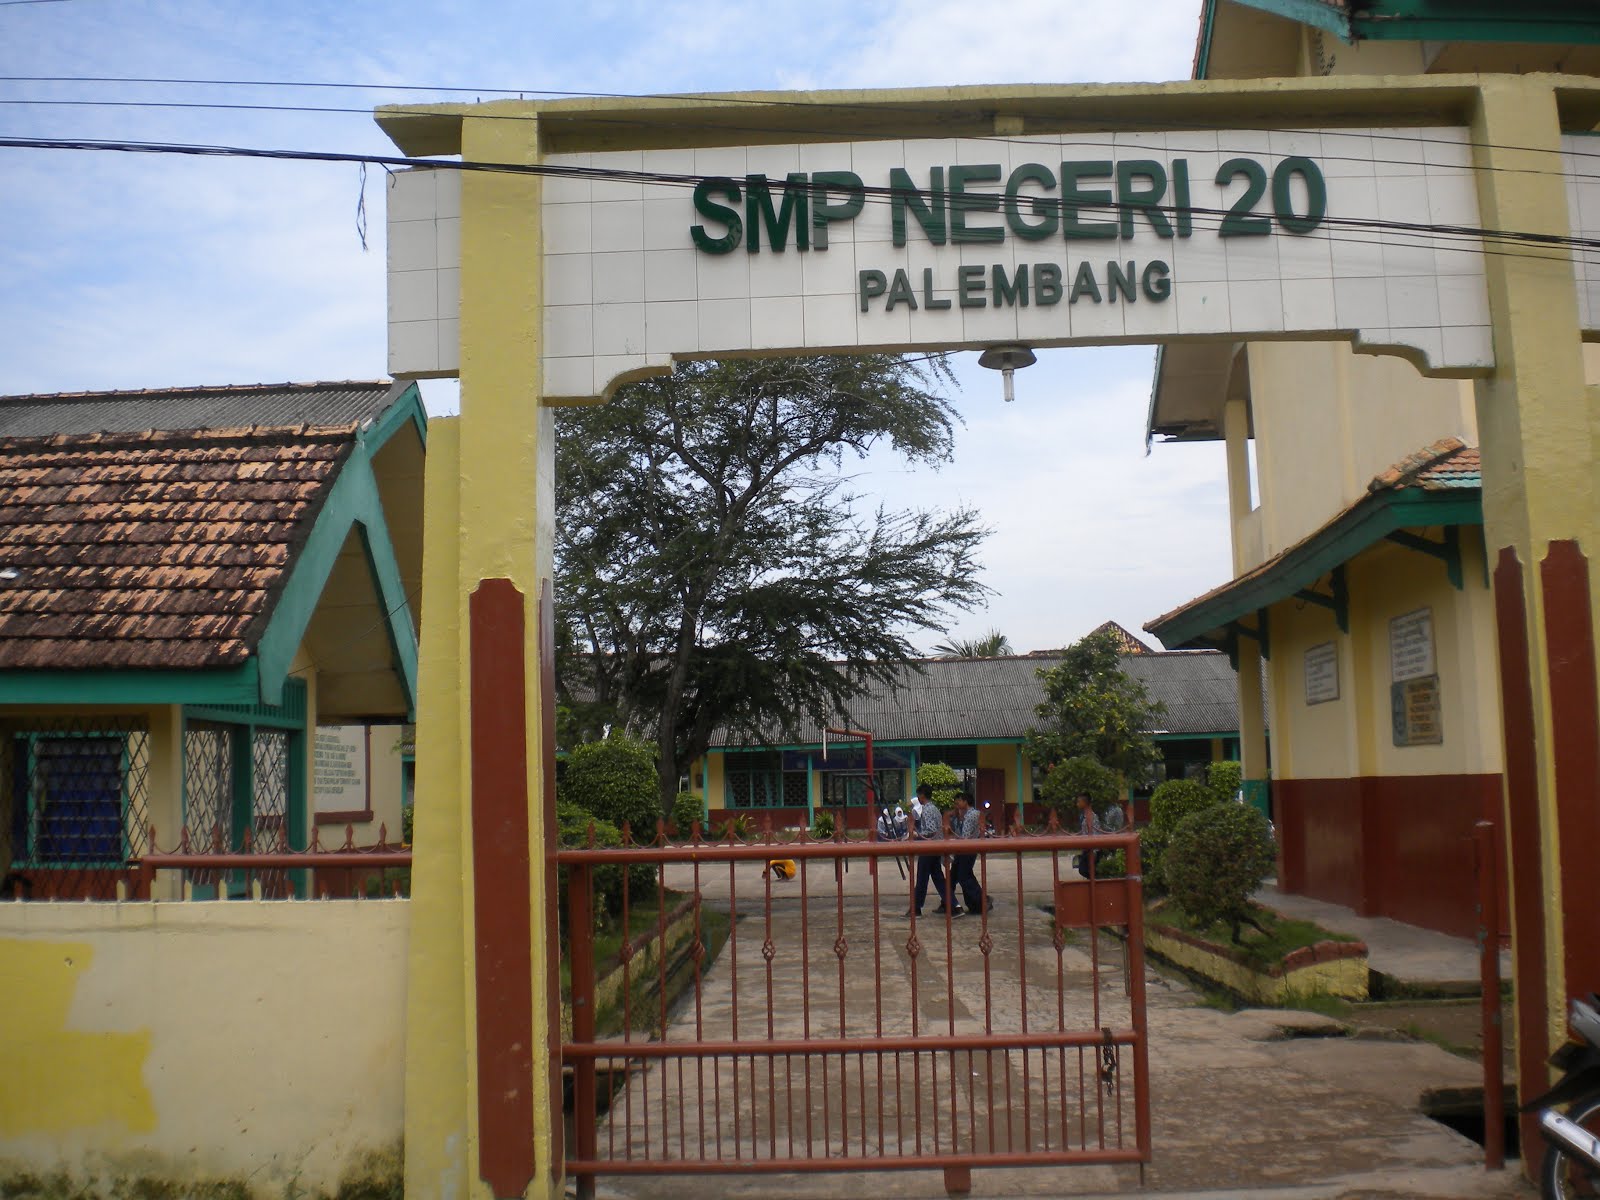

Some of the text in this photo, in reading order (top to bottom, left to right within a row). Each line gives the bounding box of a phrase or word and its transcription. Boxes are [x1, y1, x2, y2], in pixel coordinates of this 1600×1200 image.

[690, 156, 1327, 254] SMP NEGERI 20
[859, 260, 1172, 312] PALEMBANG
